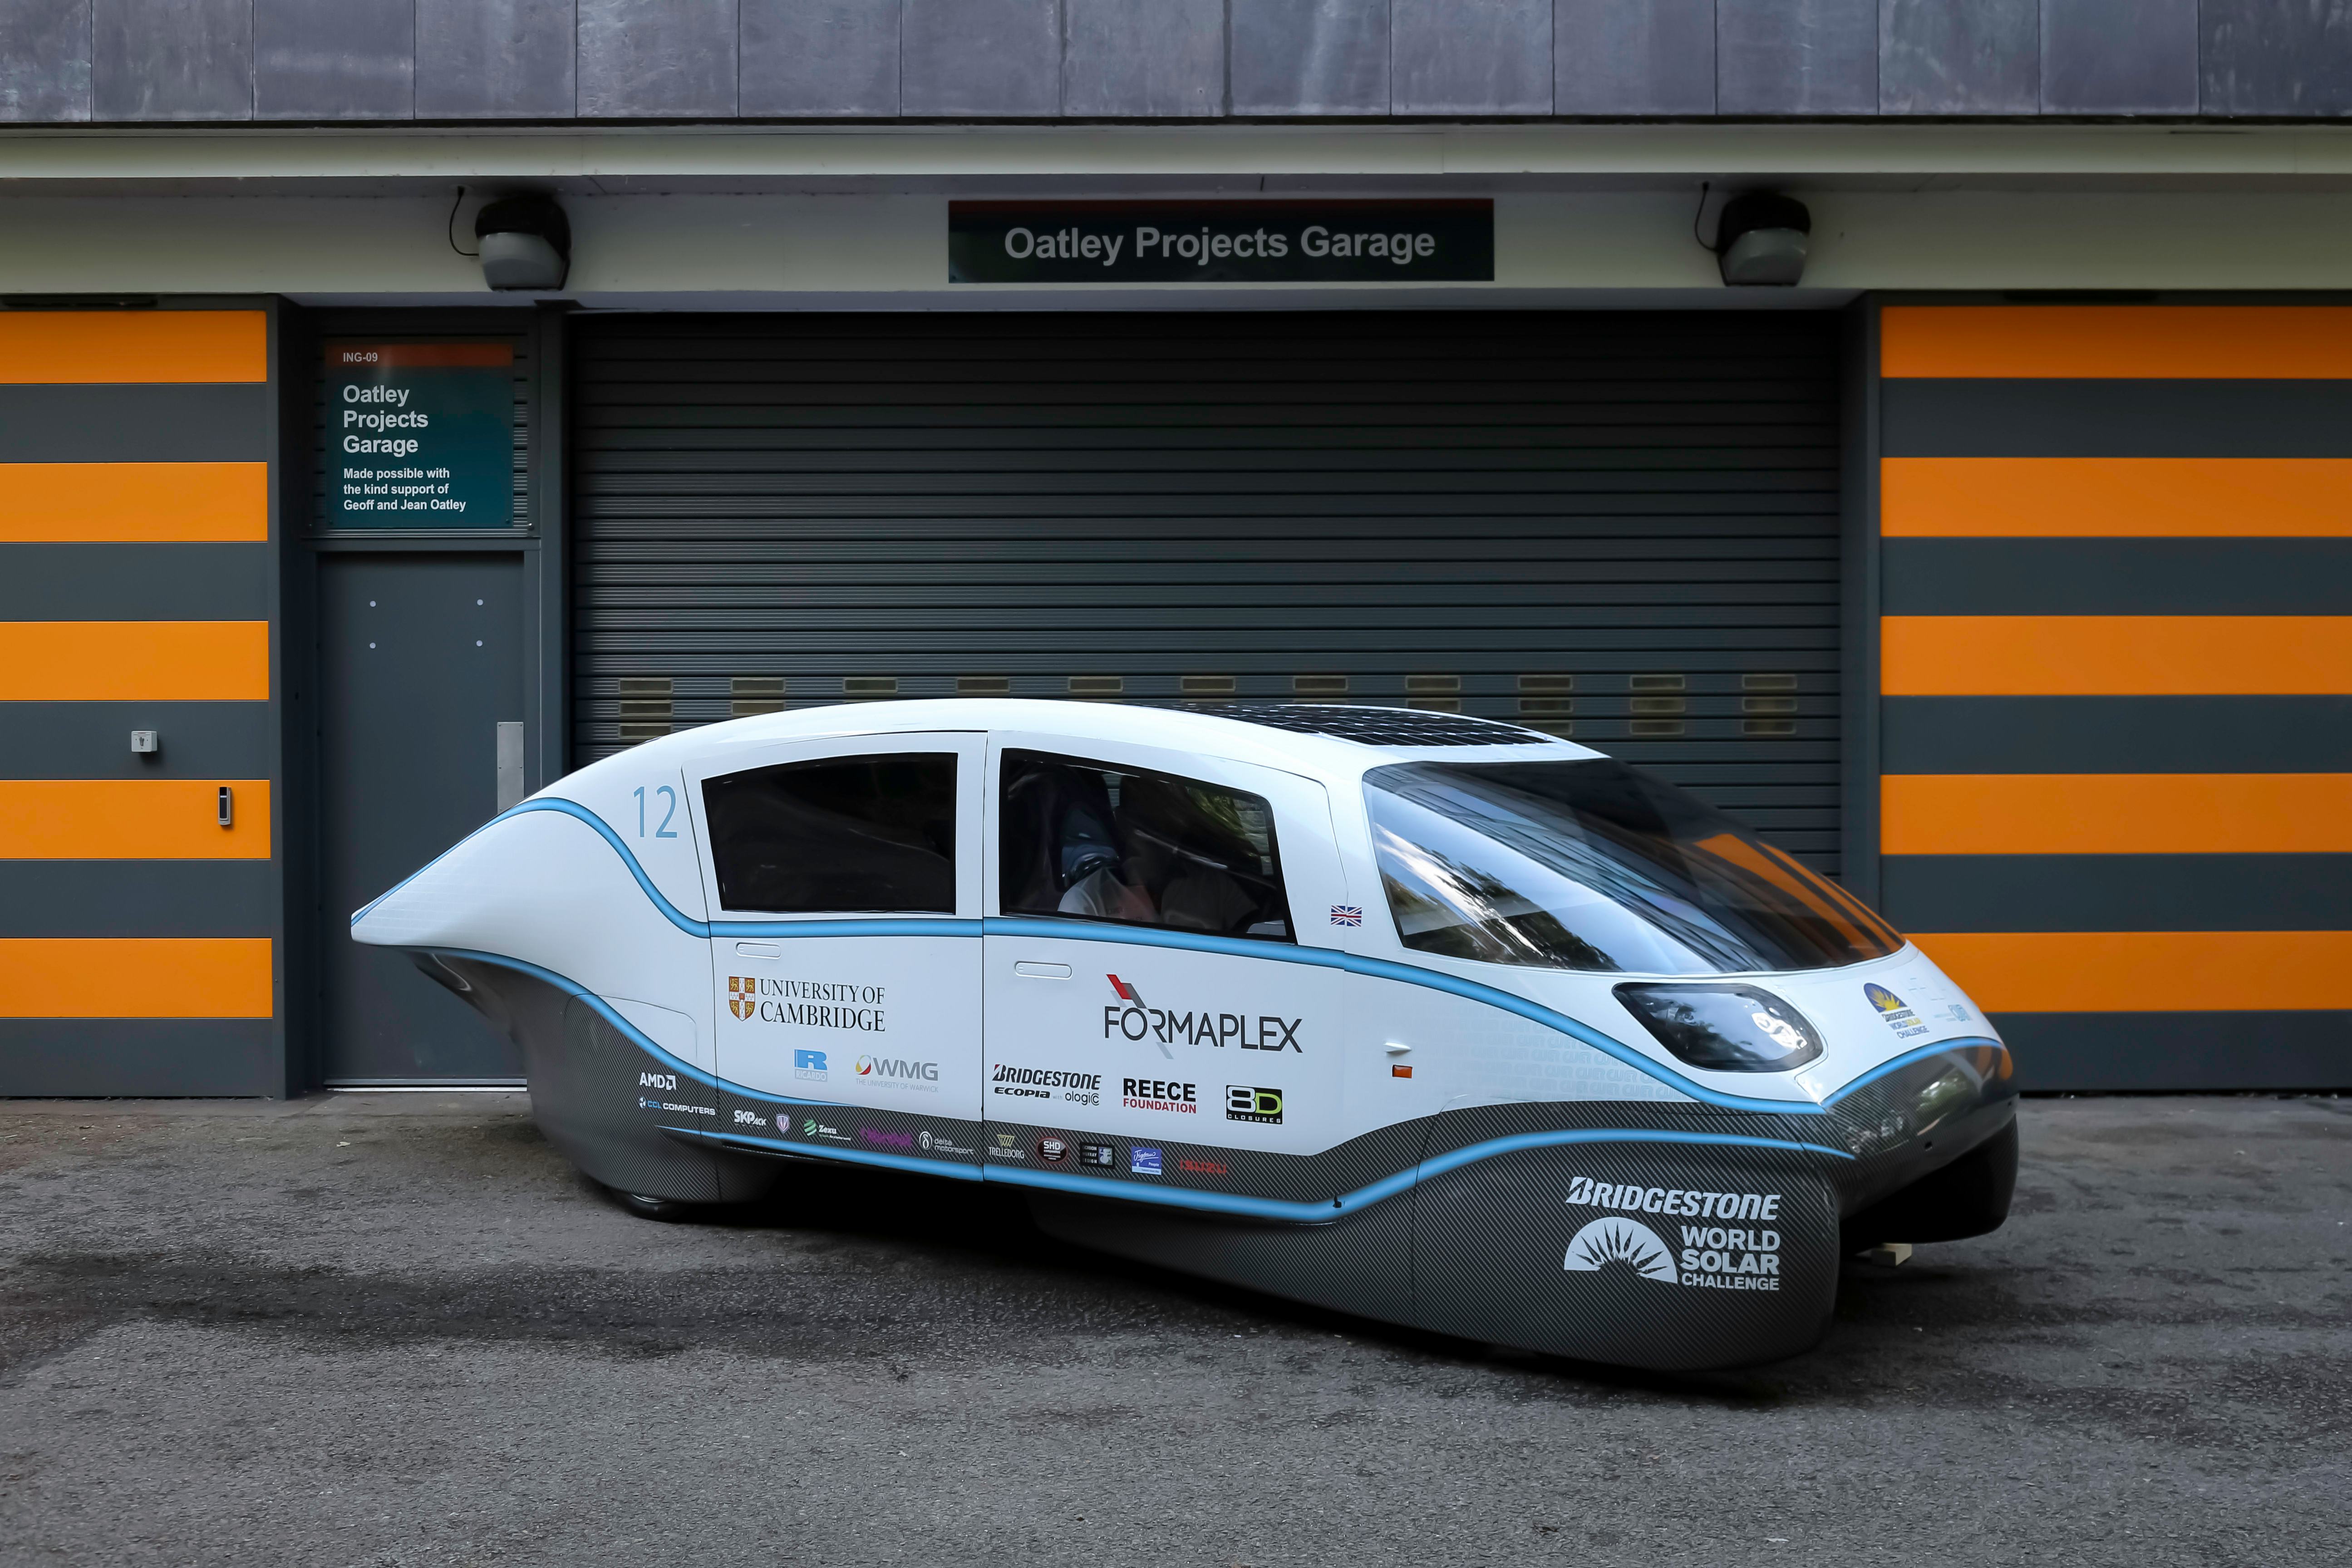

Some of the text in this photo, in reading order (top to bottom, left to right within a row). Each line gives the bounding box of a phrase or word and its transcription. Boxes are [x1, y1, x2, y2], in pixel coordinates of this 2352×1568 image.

[1004, 225, 1436, 266] Oatley Projects Garage
[343, 353, 378, 362] ING-09
[344, 385, 409, 407] Oatley
[344, 410, 428, 432] Projects
[344, 435, 418, 457] Garage
[344, 467, 450, 481] Made possible with
[344, 483, 449, 496] the kind support of
[344, 499, 466, 512] Geoff and Jean Oatley
[633, 785, 678, 838] 12
[760, 978, 886, 1005] UNIVERSITY OF
[760, 1001, 886, 1032] CAMBRIDGE
[1105, 1006, 1303, 1053] FORMAPLEX
[796, 1071, 826, 1081] RICARDO
[873, 1057, 938, 1081] WMG
[992, 1064, 1102, 1090] BRIDGESTONE
[640, 1072, 665, 1088] AMD
[867, 1080, 899, 1089] UNIVERSITY
[910, 1084, 939, 1093] WARWICK
[1123, 1078, 1196, 1102] REECE
[648, 1100, 716, 1116] CCL COMPUTERS
[1123, 1098, 1196, 1114] FOUNDATION
[1227, 1086, 1282, 1115] 8D
[1228, 1114, 1280, 1123] CLOSURES
[819, 1125, 836, 1134] Zexu
[935, 1138, 952, 1146] delta
[935, 1145, 974, 1155] motorsport
[1043, 1140, 1061, 1150] SHD
[989, 1146, 1024, 1159] TRELLEBORG
[1180, 1160, 1226, 1174] ISUZU
[1565, 1176, 1781, 1220] BRIDGESTONE
[1681, 1225, 1781, 1251] WORLD
[1680, 1249, 1779, 1275] SOLAR
[1682, 1273, 1779, 1291] CHALLENGE
